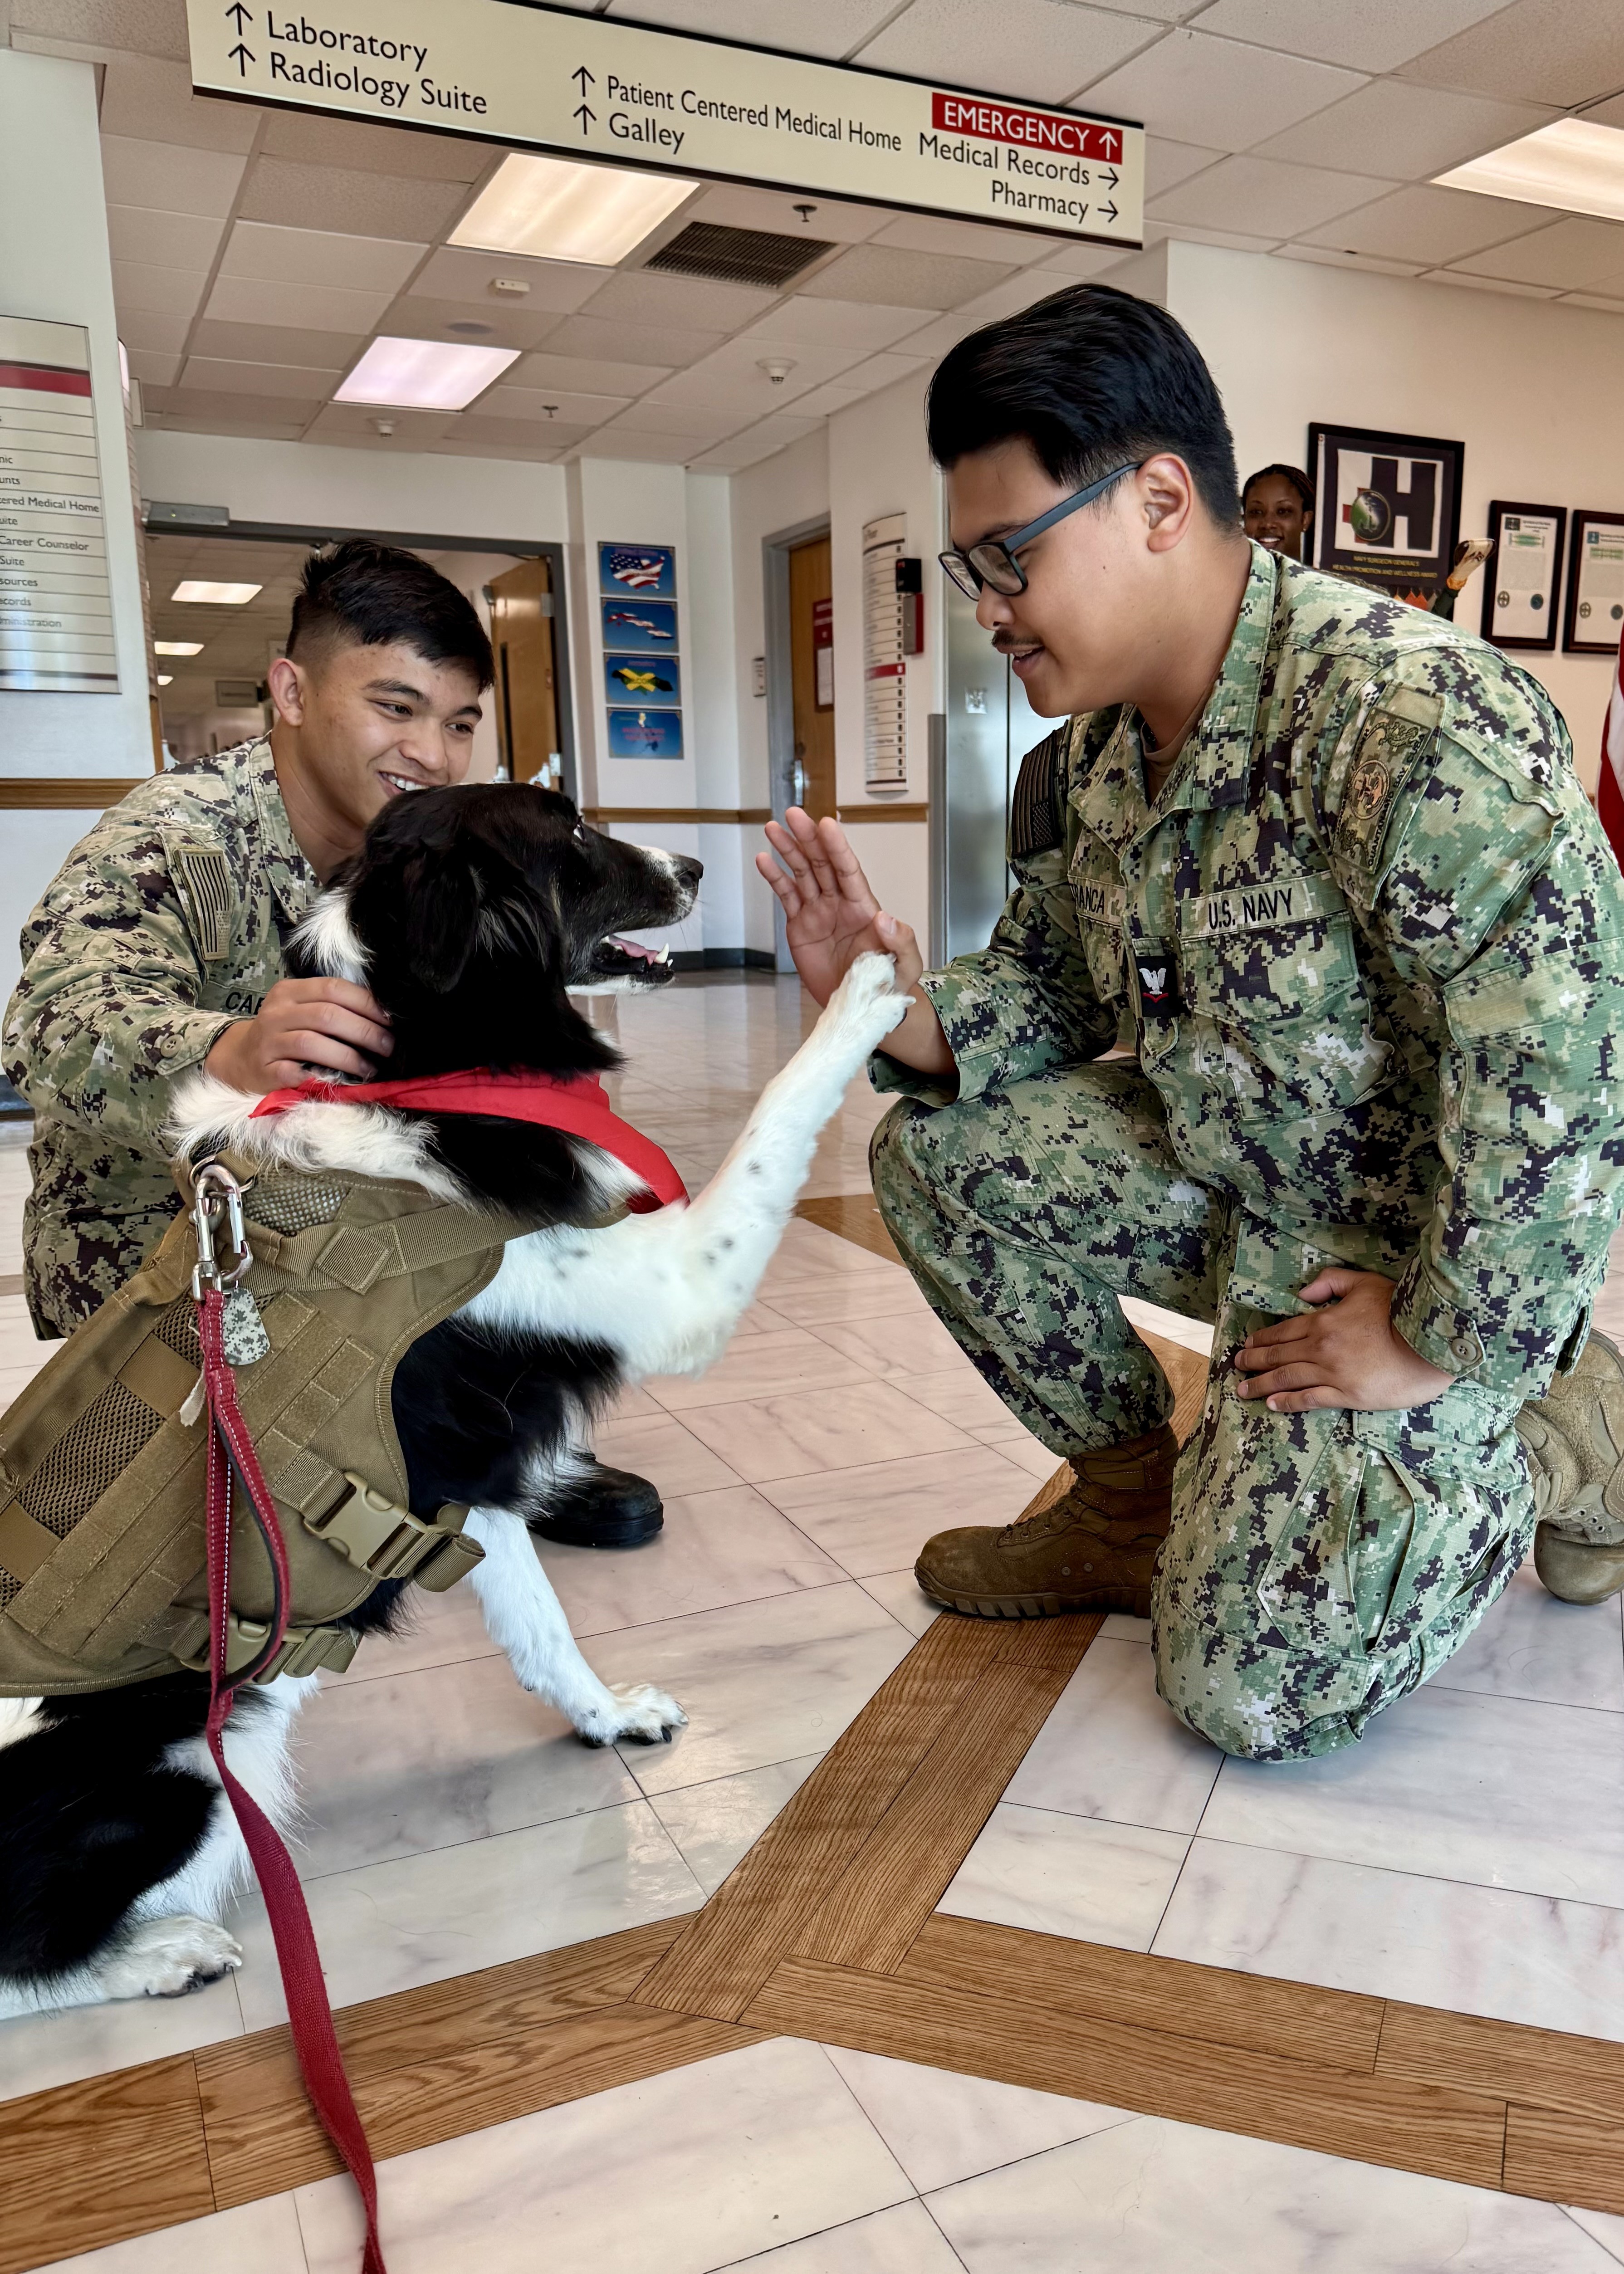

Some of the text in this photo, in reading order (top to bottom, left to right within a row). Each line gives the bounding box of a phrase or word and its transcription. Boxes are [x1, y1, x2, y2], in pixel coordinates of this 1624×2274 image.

[267, 10, 427, 72] Laboratory
[270, 51, 487, 114] Radiology Suite
[607, 75, 902, 152] Patient Centered Medical Home
[609, 112, 685, 155] Galley
[944, 101, 1090, 152] EMERGENCY
[920, 132, 1090, 185] Medical Records
[992, 180, 1089, 224] Pharmacy
[28, 497, 66, 509] Medical
[69, 501, 99, 512] Home
[0, 536, 89, 551] Career Counselor
[0, 556, 24, 566] Suite
[1208, 887, 1292, 929] U.S. NAVY
